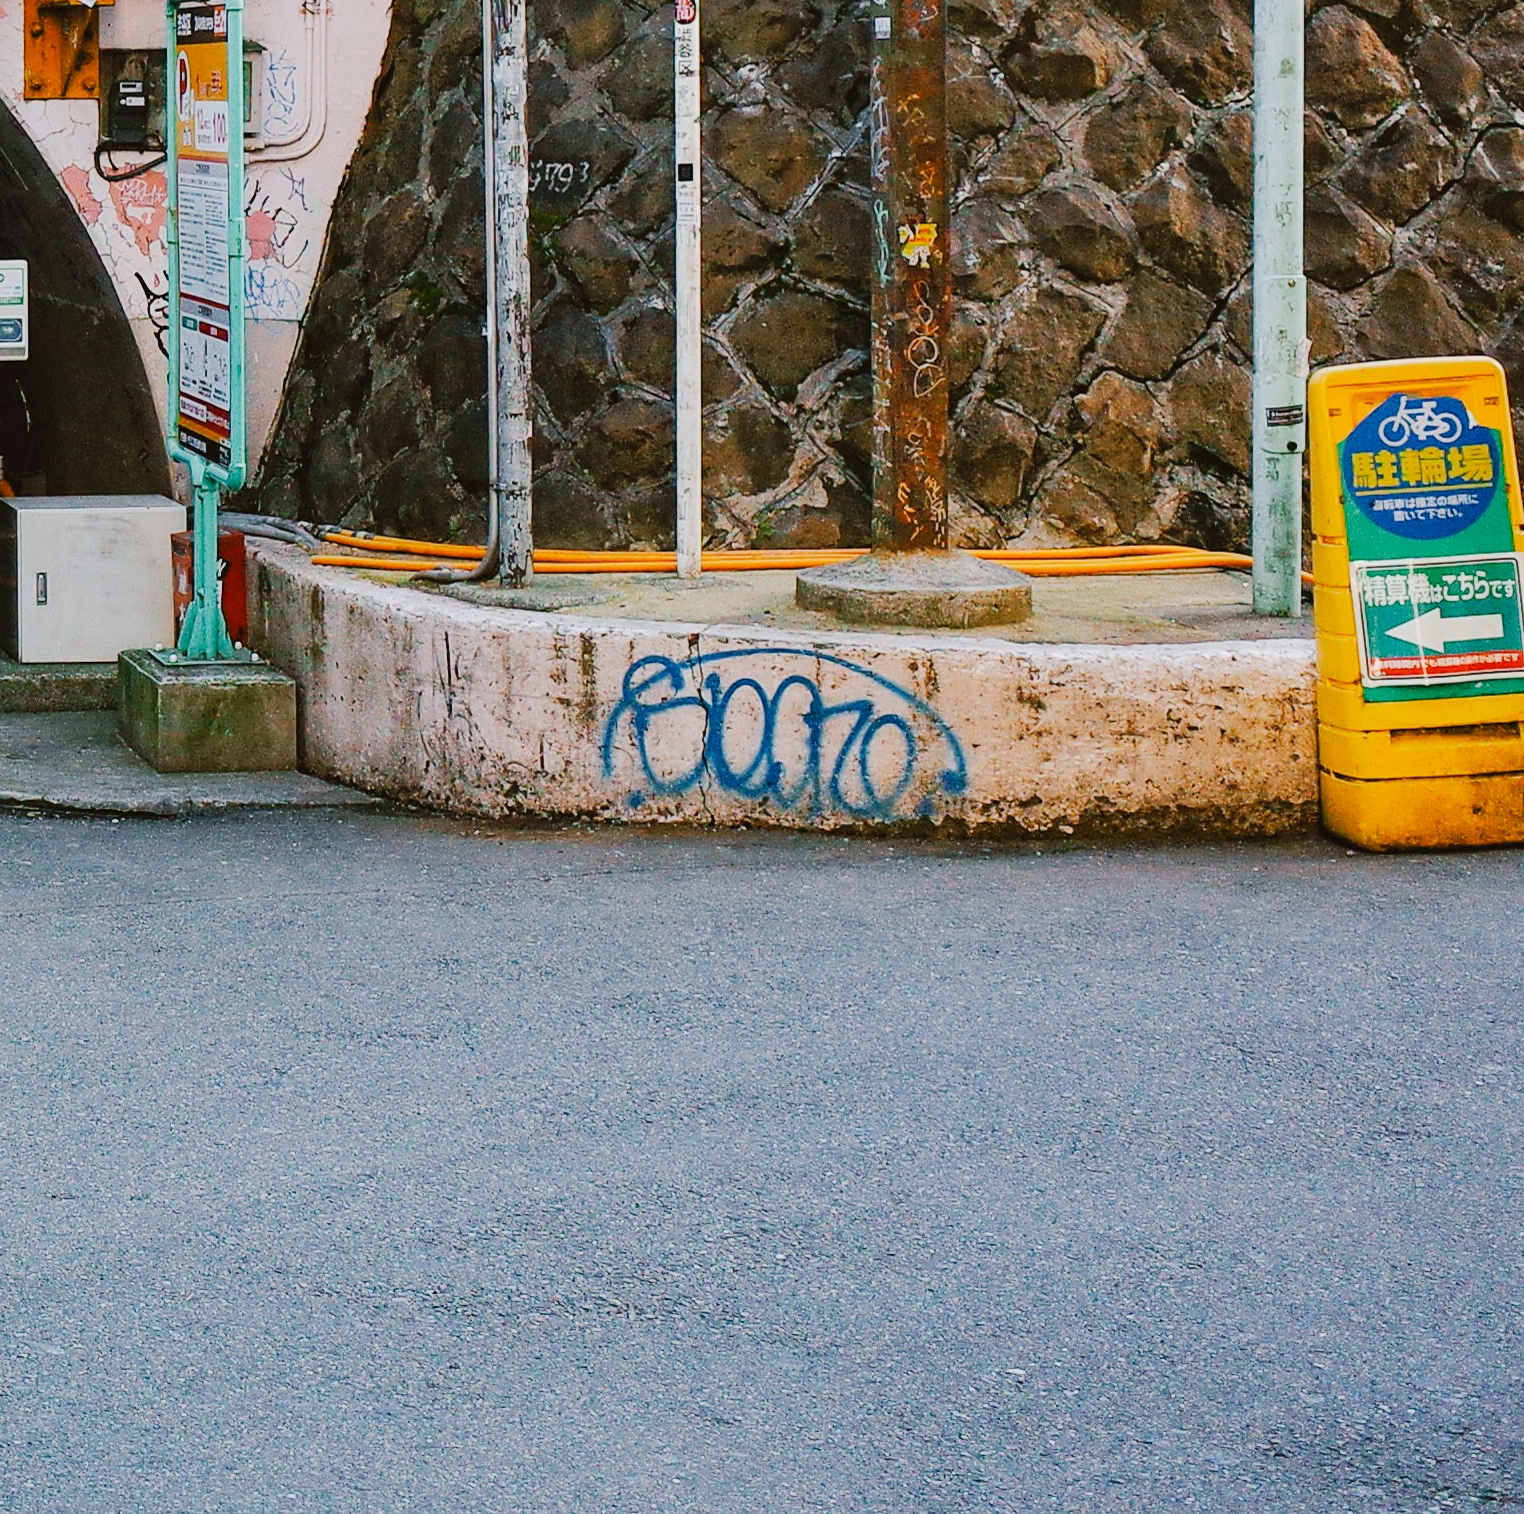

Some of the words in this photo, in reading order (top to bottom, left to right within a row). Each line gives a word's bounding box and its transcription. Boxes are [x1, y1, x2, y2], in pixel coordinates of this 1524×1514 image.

[1352, 443, 1494, 490] 駐輪場
[1364, 570, 1517, 607] 精算機はこちらです
